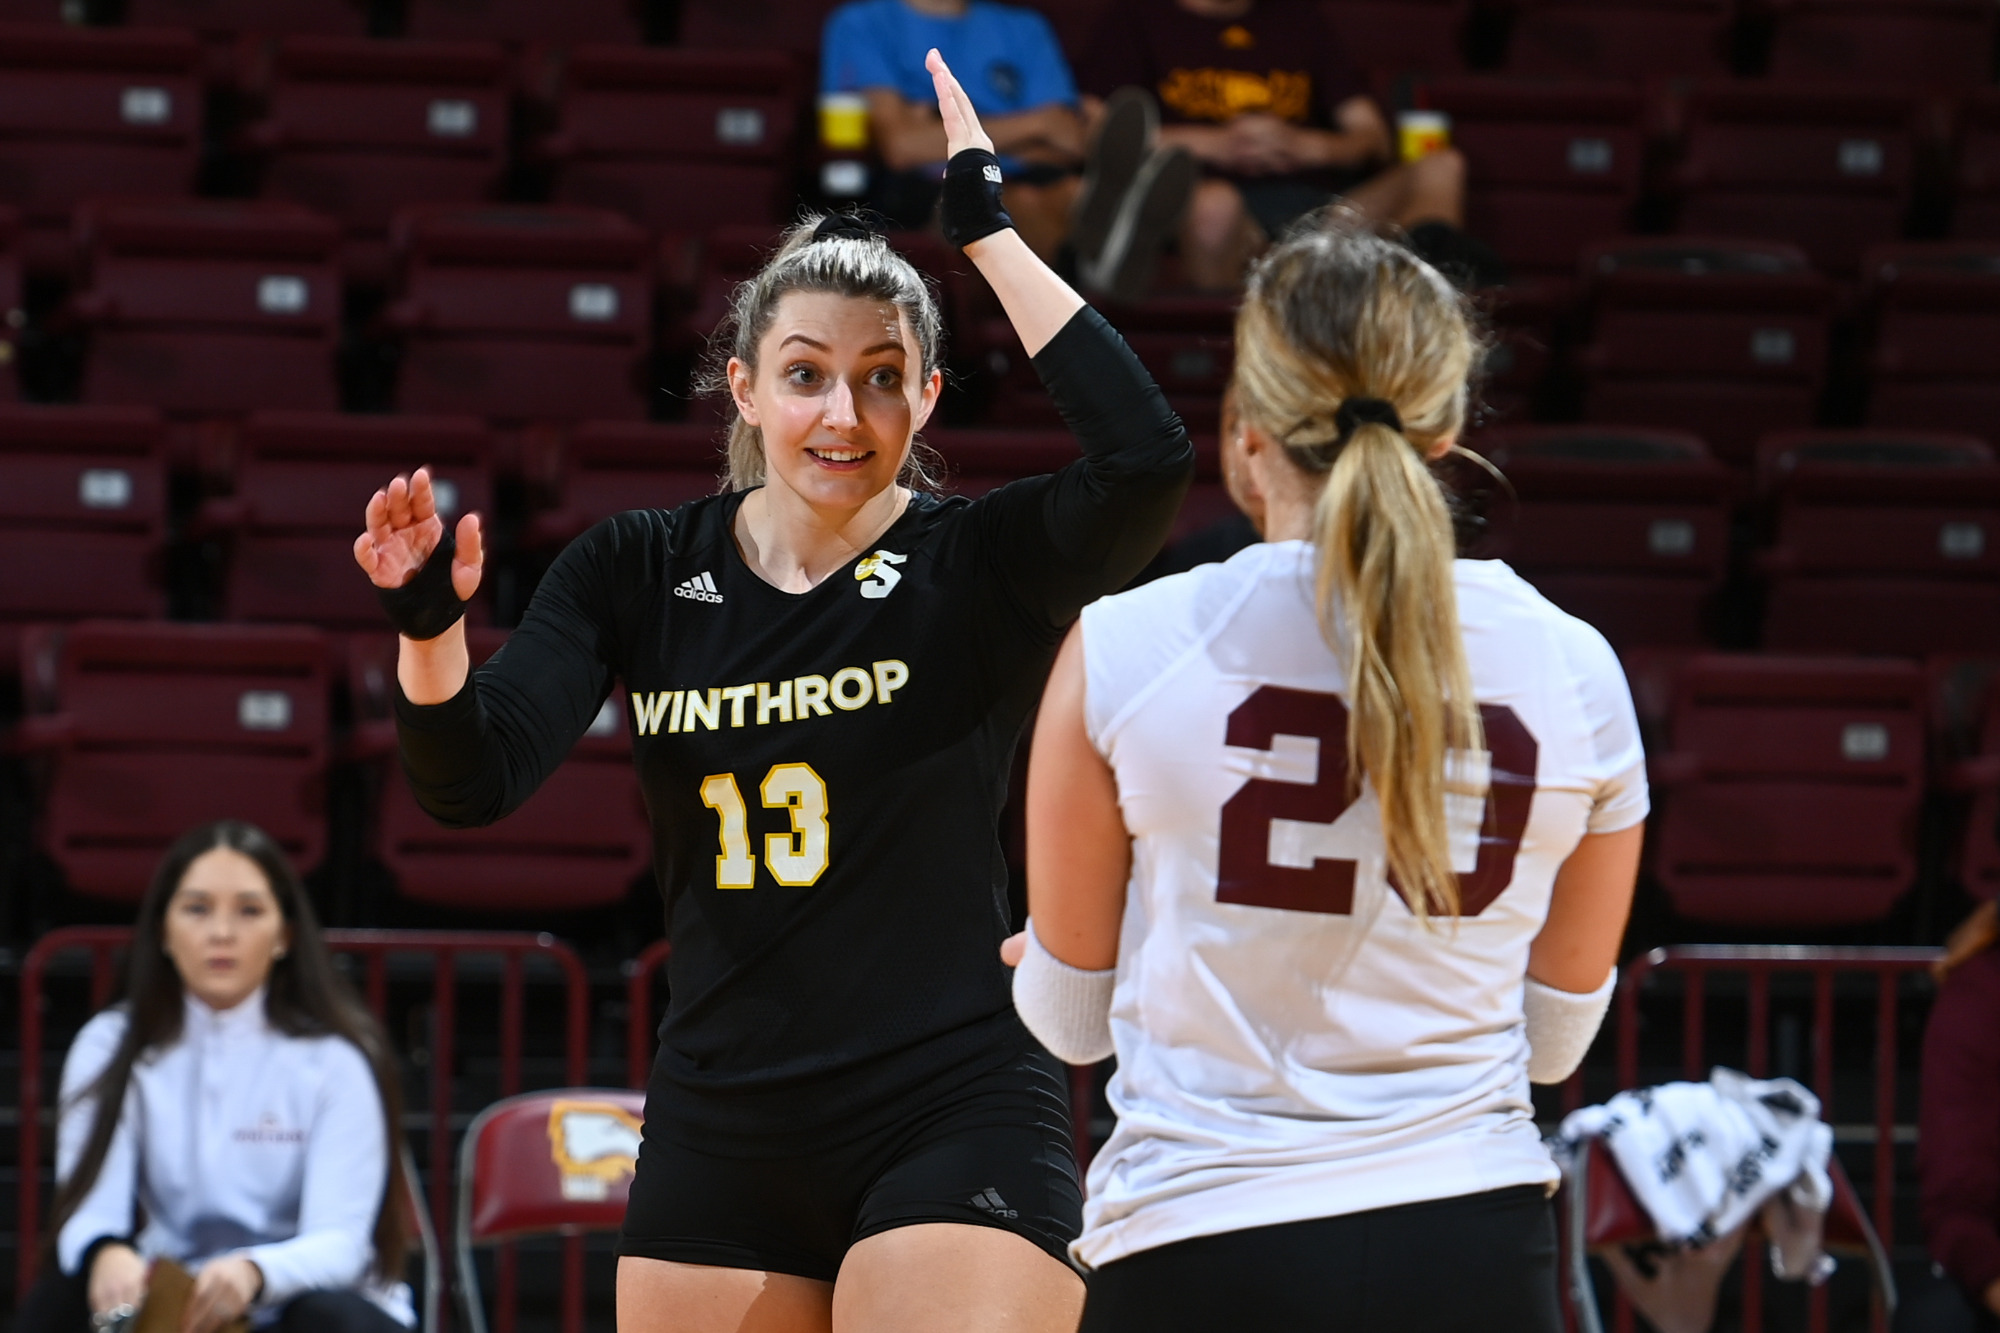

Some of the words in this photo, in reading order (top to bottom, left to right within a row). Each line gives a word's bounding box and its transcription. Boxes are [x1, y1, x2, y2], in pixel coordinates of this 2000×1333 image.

[674, 587, 724, 603] adidas
[632, 659, 909, 736] WINTHROP
[699, 762, 829, 889] 13
